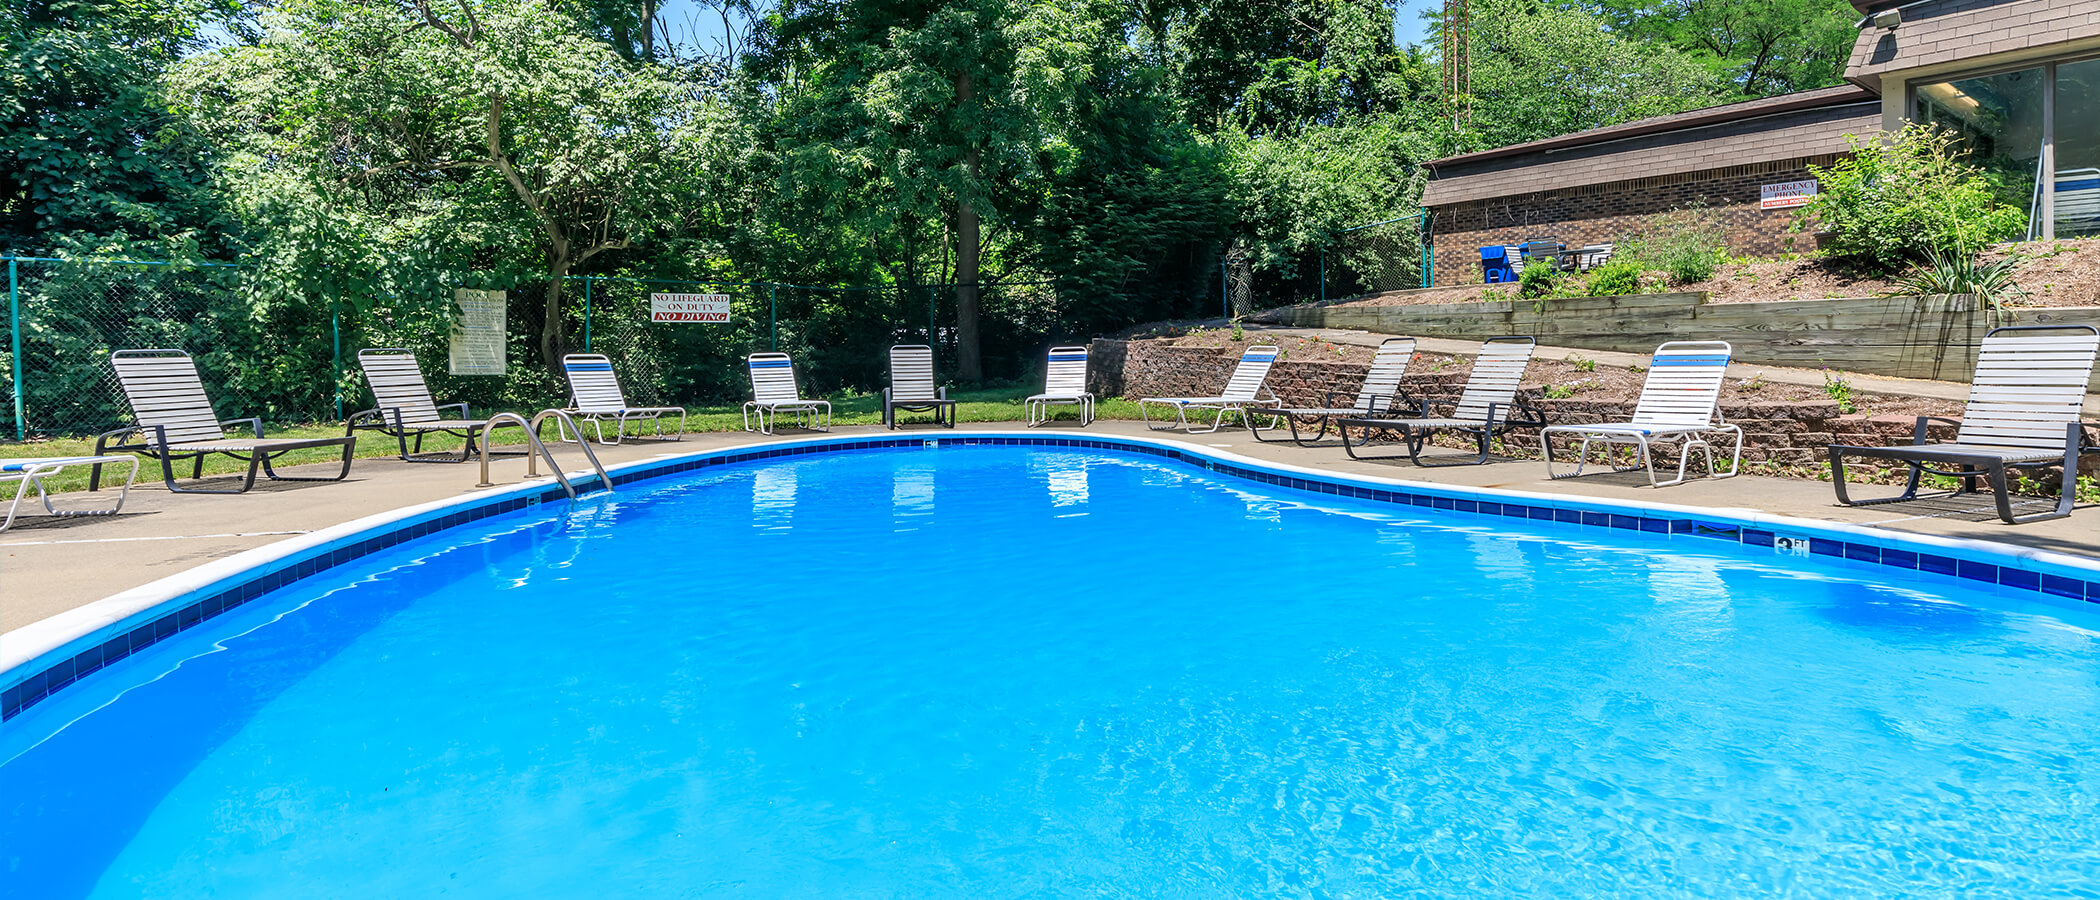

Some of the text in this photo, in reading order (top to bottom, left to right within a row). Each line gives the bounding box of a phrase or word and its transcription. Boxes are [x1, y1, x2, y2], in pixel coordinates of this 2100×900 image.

[1763, 182, 1815, 192] EMERGENCY
[658, 312, 727, 320] NO DIVING
[1794, 538, 1806, 548] FT
